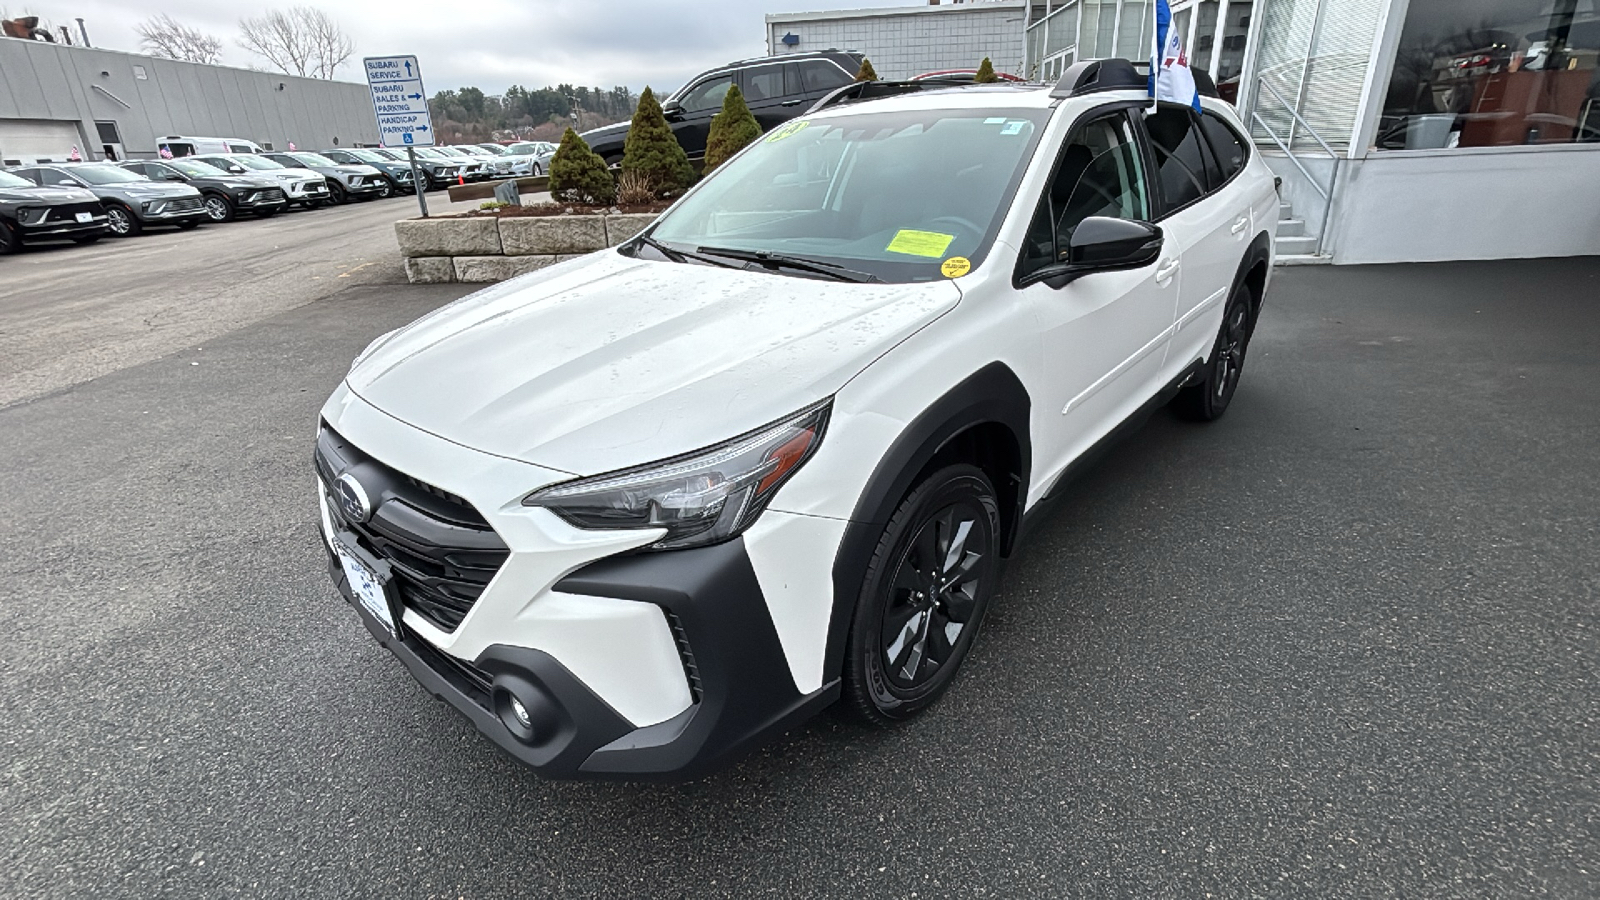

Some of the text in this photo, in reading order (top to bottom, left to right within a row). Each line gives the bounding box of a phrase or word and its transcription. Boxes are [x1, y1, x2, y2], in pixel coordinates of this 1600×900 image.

[368, 61, 398, 69] SUBARU
[370, 71, 401, 79] SERVICE
[373, 85, 404, 93] SUBARU
[378, 104, 410, 112] PARKING
